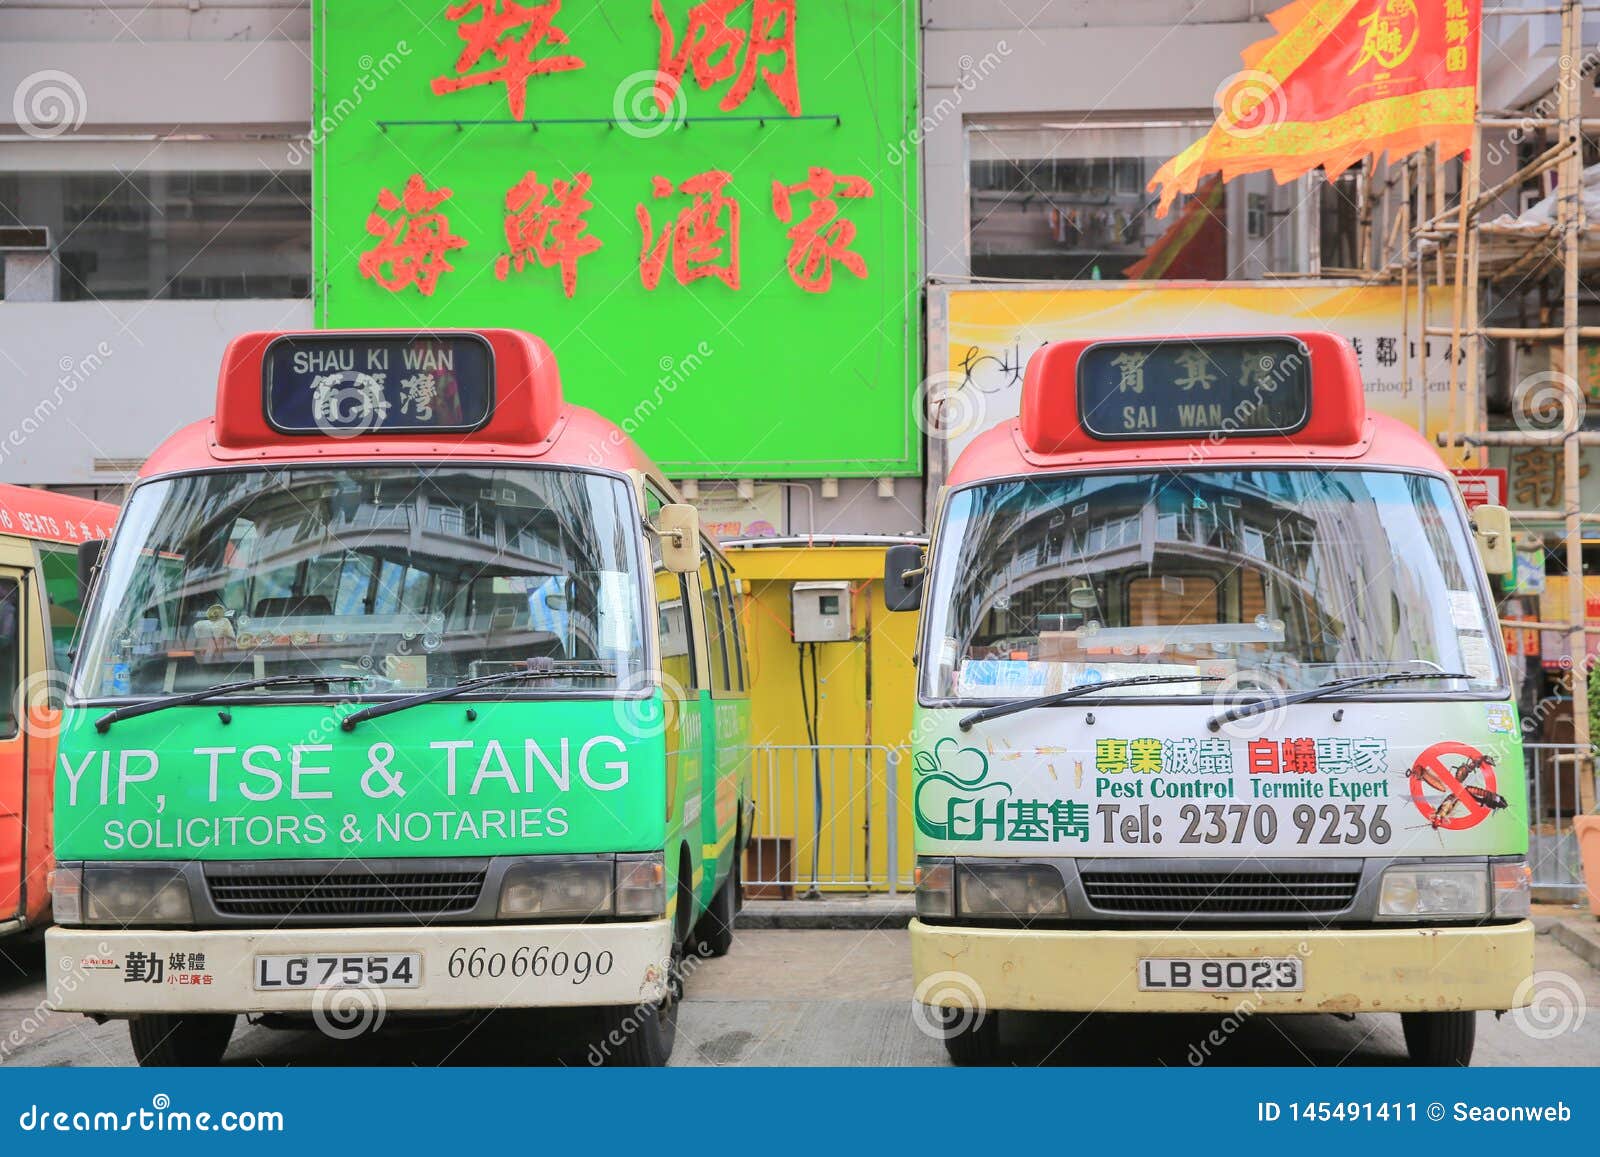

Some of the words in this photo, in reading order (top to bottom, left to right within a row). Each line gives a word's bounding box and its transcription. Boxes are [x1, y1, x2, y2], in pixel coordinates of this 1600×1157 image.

[358, 166, 875, 298] 海鮮酒家
[293, 349, 354, 374] SHAU
[367, 349, 389, 370] KI
[402, 349, 453, 371] WAN
[1123, 405, 1157, 429] SAI
[1178, 404, 1222, 427] WAN
[18, 512, 60, 536] SEATS
[64, 520, 113, 541] 公共小
[1095, 737, 1234, 775] 專業滅蟲
[1247, 737, 1389, 775] 白蟻專家
[60, 750, 165, 814] YIP,
[193, 743, 334, 802] TSE
[360, 742, 408, 799] &
[430, 735, 629, 796] TANG
[1096, 777, 1143, 798] Pest
[1150, 777, 1235, 798] Control
[1250, 778, 1324, 798] Termite
[1329, 777, 1389, 801] Expert
[103, 814, 327, 850] SOLICITORS
[339, 813, 364, 844] &
[376, 807, 569, 842] NOTARIES
[1096, 803, 1162, 844] Tel:
[1179, 803, 1278, 845] 2370
[1292, 803, 1392, 845] 9236
[168, 952, 206, 971] 媒體
[260, 959, 308, 987] LG
[316, 957, 413, 985] 7554
[447, 946, 614, 985] 66066090
[1145, 961, 1192, 988] LB
[1201, 962, 1298, 988] 9023
